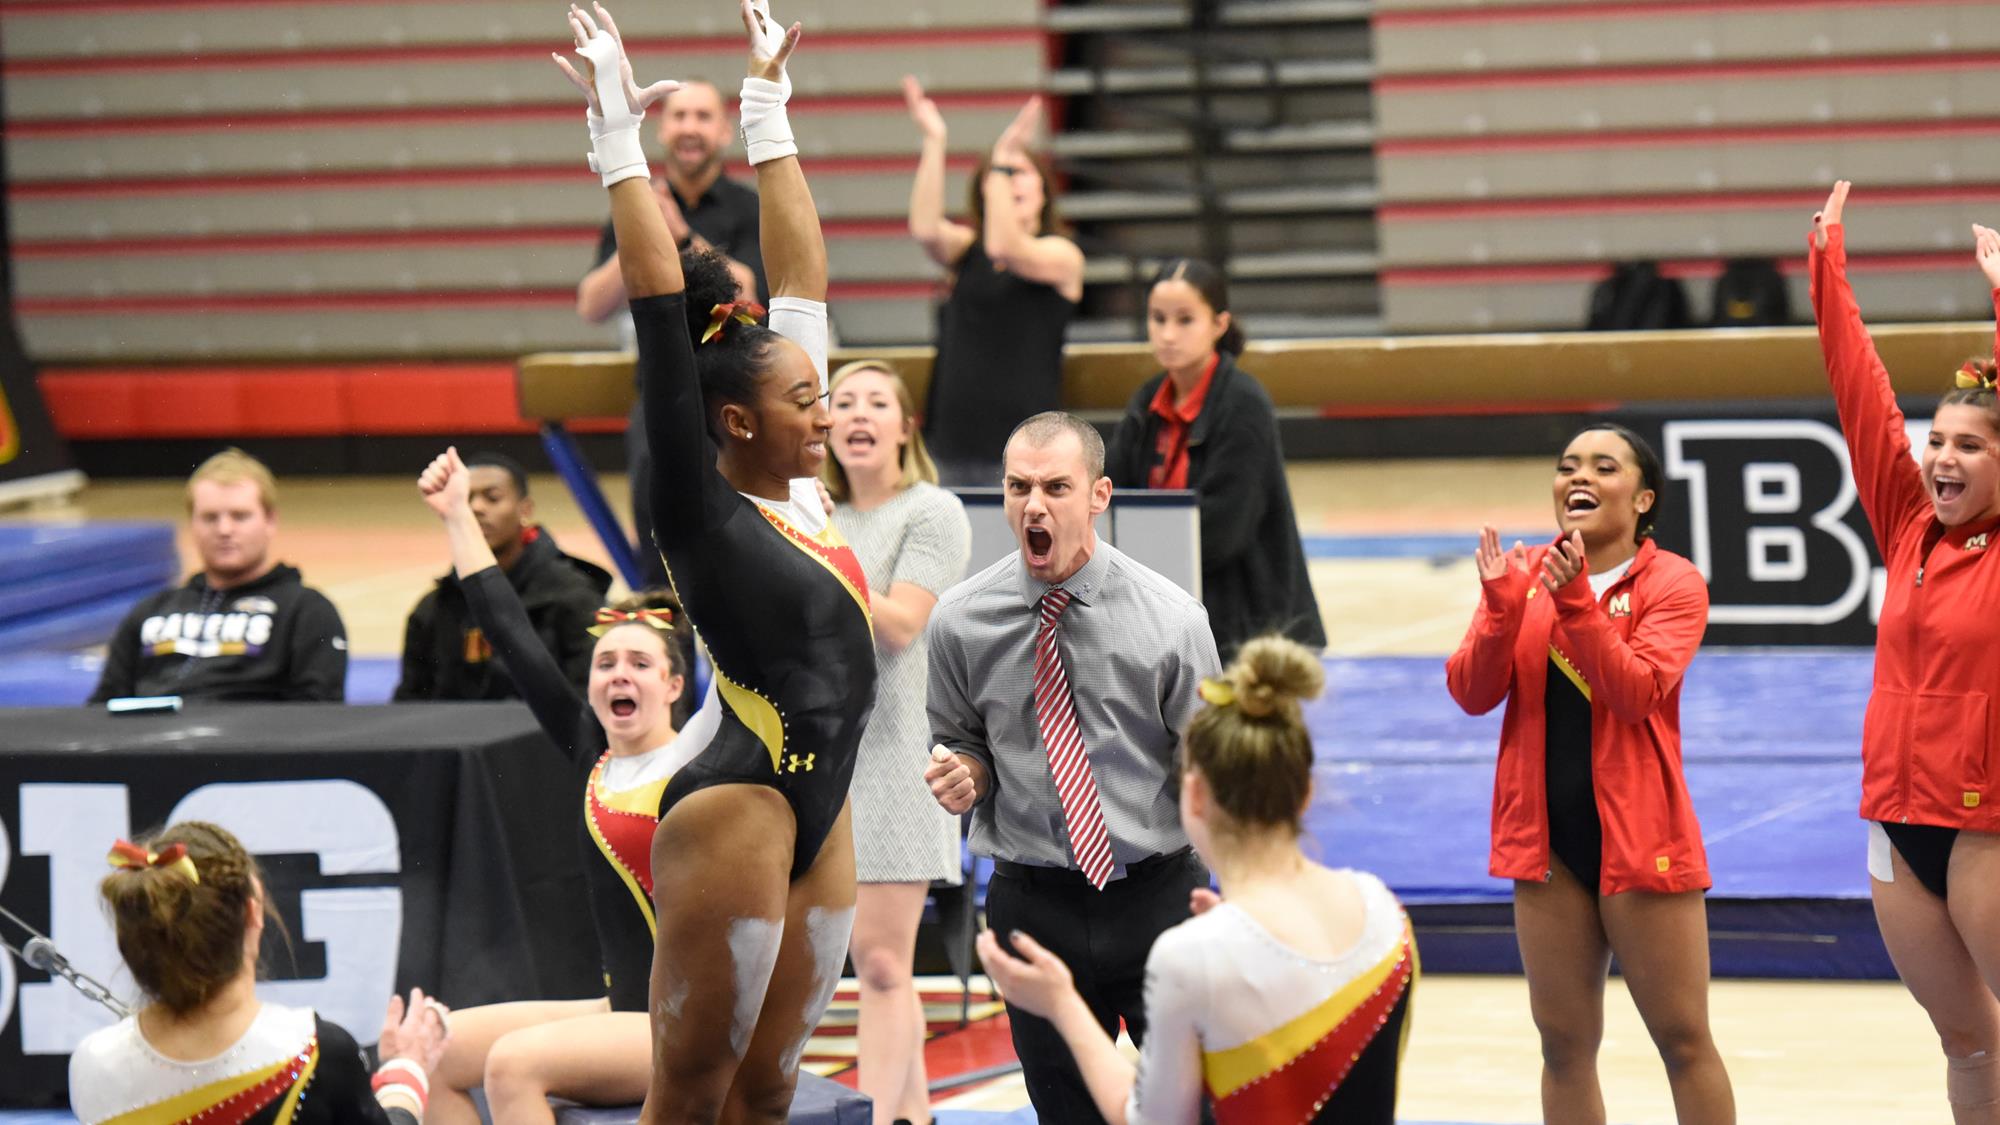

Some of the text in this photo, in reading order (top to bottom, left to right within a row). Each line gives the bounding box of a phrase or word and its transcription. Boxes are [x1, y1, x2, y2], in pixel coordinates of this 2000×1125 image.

[1965, 532, 1988, 548] M
[1609, 592, 1631, 615] M
[140, 612, 273, 646] RAVENS
